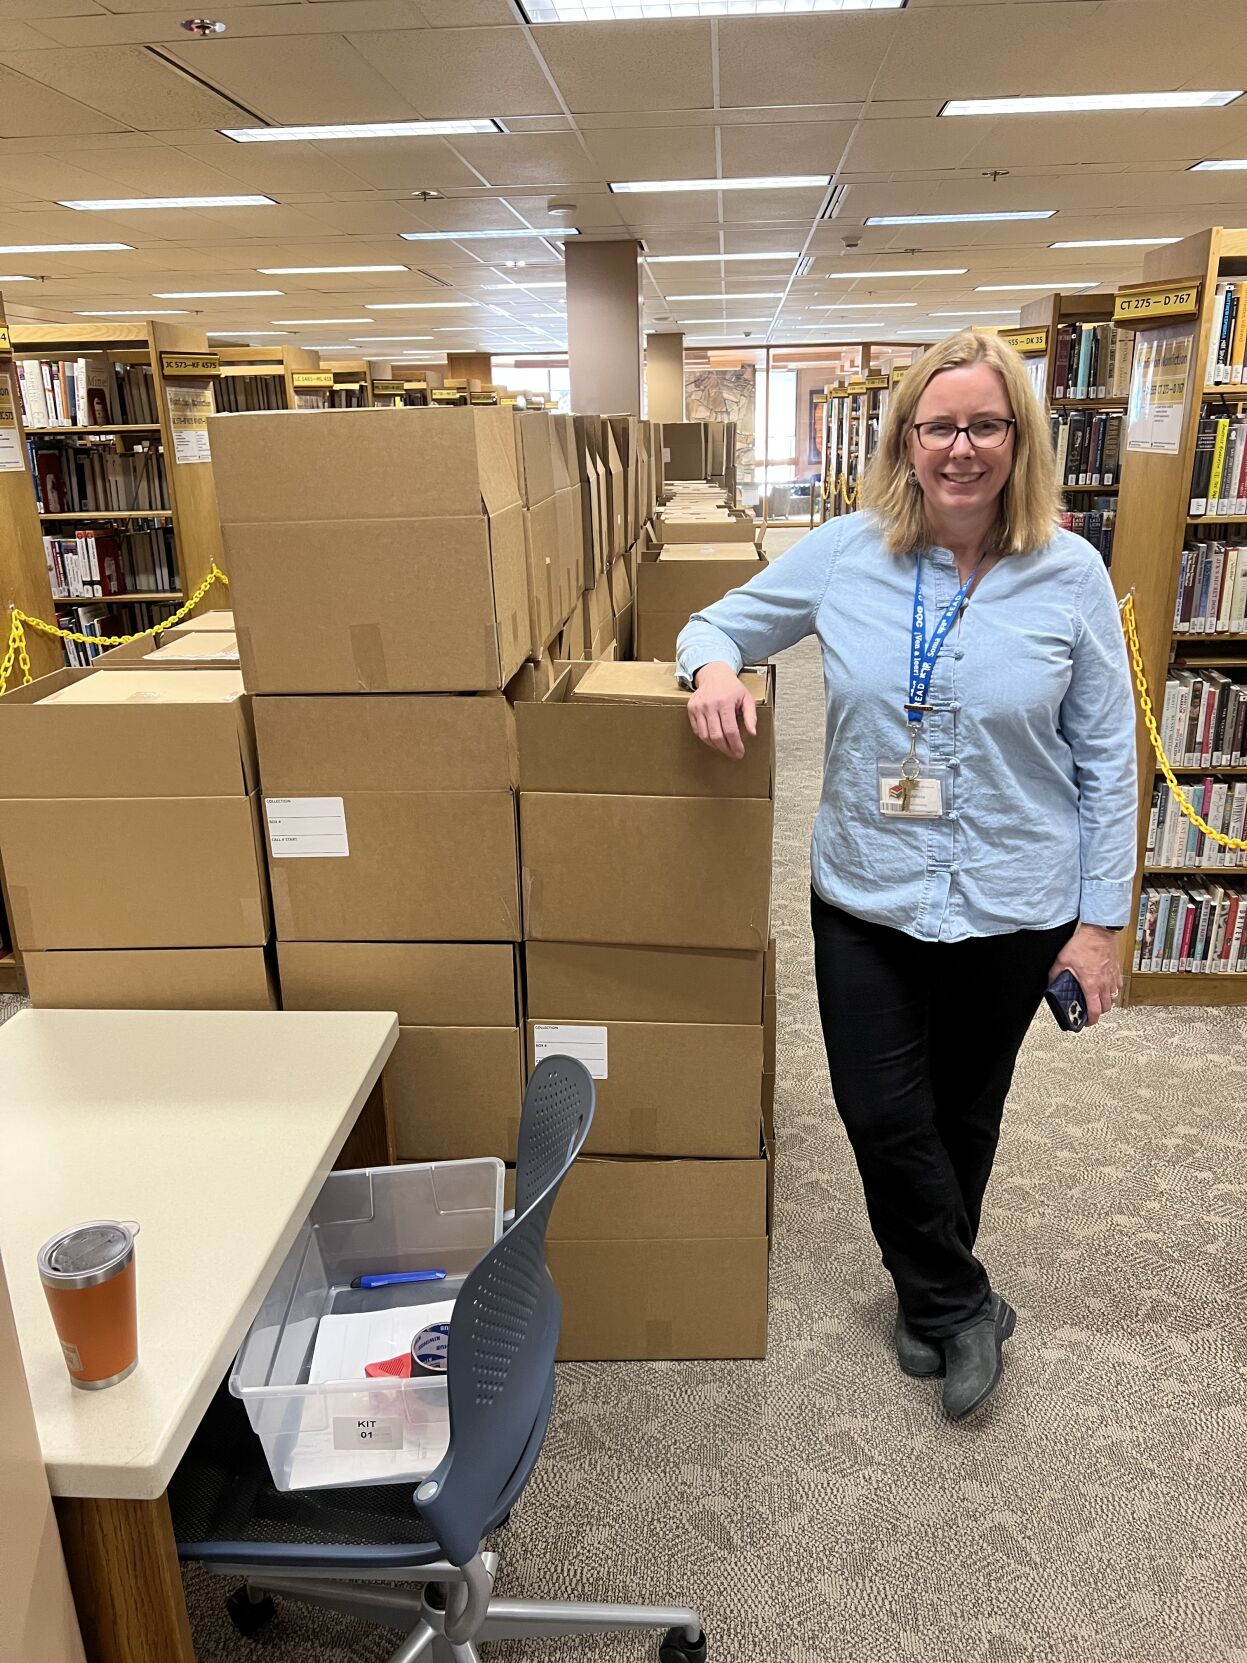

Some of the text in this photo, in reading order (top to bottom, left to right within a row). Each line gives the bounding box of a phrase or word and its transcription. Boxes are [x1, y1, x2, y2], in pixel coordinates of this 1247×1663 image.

[1120, 301, 1131, 310] CT
[1134, 298, 1151, 309] 275
[1163, 296, 1171, 306] D
[1173, 293, 1191, 305] 767
[946, 595, 962, 616] READ
[1235, 910, 1244, 941] DRIVEN
